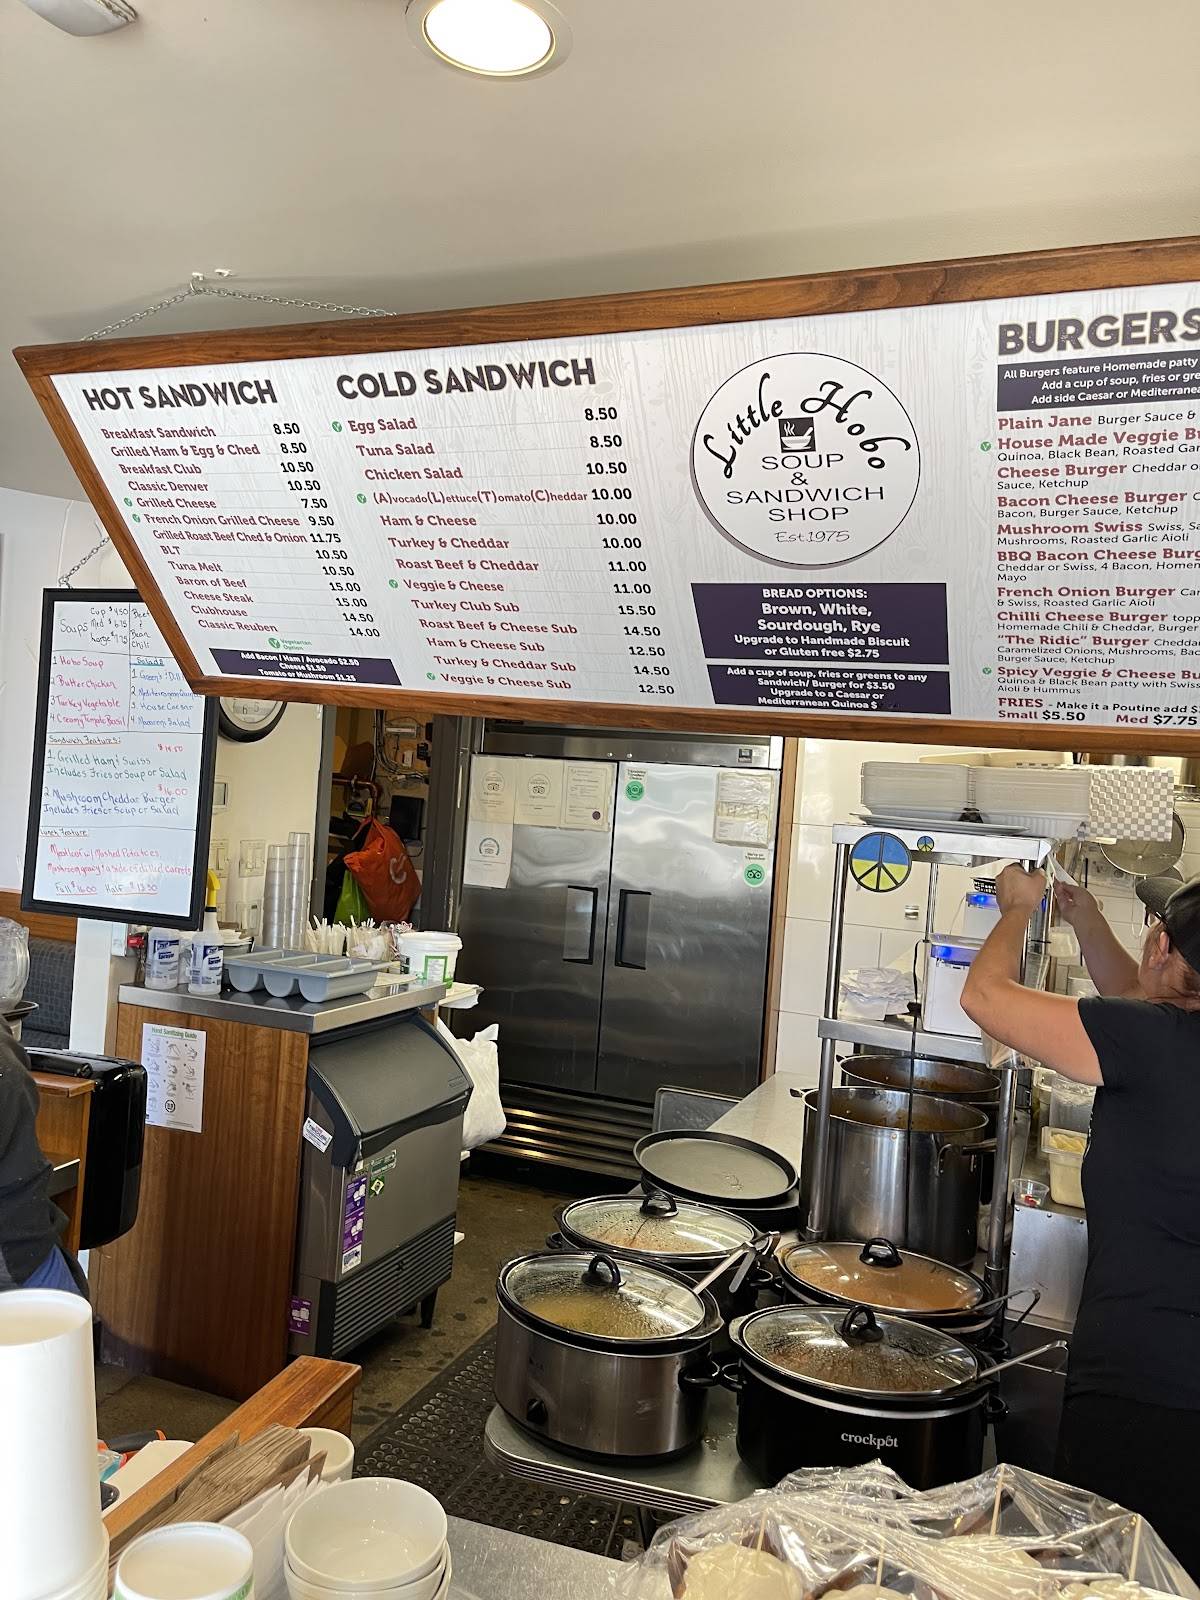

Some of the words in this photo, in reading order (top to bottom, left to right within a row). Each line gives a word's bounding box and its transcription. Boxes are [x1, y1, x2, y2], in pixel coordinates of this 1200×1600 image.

[998, 308, 1200, 356] BURGERS
[1004, 370, 1017, 379] All
[1020, 369, 1060, 378] Burgers
[1062, 366, 1100, 374] feature
[1103, 360, 1166, 371] Homemade
[1169, 358, 1198, 369] patty
[337, 372, 416, 399] COLD
[424, 358, 596, 394] SANDWICH
[82, 387, 134, 410] HOT
[139, 380, 277, 408] SANDWICH
[348, 420, 375, 434] Egg
[378, 418, 417, 430] Salad
[585, 407, 617, 420] 8.50
[704, 373, 782, 478] Little
[800, 380, 911, 469] Hobo
[998, 417, 1043, 430] Plain
[1048, 416, 1092, 427] Jane
[1098, 416, 1141, 425] Burger
[1144, 413, 1182, 422] Sauce
[1187, 410, 1196, 419] &
[101, 428, 156, 438] Breakfast
[157, 426, 216, 438] Sandwich
[273, 423, 300, 434] 8.50
[111, 446, 150, 456] Grilled
[150, 446, 179, 456] Ham
[180, 446, 188, 456] &
[190, 446, 214, 458] Egg
[216, 445, 224, 455] &
[227, 444, 260, 455] Ched
[280, 442, 306, 453] 8.50
[356, 445, 393, 456] Tuna
[396, 443, 435, 455] Salad
[590, 435, 622, 448] 8.50
[118, 464, 172, 474] Breakfast
[174, 464, 201, 474] Club
[280, 462, 314, 472] 10.50
[762, 454, 843, 470] SOUP
[365, 469, 422, 480] Chicken
[424, 467, 463, 479] Salad
[586, 462, 627, 474] 10.50
[998, 467, 1059, 478] Cheese
[1065, 464, 1127, 477] Burger
[1132, 462, 1187, 472] Cheddar
[128, 481, 167, 491] Classic
[168, 482, 208, 491] Denver
[288, 480, 320, 490] 10.50
[791, 472, 808, 485] &
[1040, 479, 1088, 488] Ketchup
[592, 488, 632, 500] 10.00
[727, 487, 883, 504] SANDWICH
[137, 498, 175, 507] Grilled
[176, 498, 216, 508] Cheese
[301, 498, 327, 508] 7.50
[144, 514, 182, 524] French
[182, 515, 217, 524] Onion
[218, 516, 257, 525] Grilled
[258, 516, 300, 526] Cheese
[308, 516, 334, 526] 9.50
[380, 516, 412, 526] Ham
[415, 515, 424, 526] &
[427, 516, 476, 526] Cheese
[597, 514, 636, 524] 10.00
[769, 507, 848, 521] SHOP
[388, 538, 434, 550] Turkey
[438, 538, 447, 548] &
[451, 538, 509, 548] Cheddar
[602, 538, 641, 548] 10.00
[1072, 535, 1118, 544] Roasted
[1122, 534, 1157, 542] Garlic
[1162, 533, 1188, 541] Aioli
[160, 546, 180, 555] BLT
[316, 550, 347, 559] 10.50
[168, 561, 197, 570] Tuna
[198, 562, 223, 572] Melt
[322, 566, 354, 576] 10.50
[396, 559, 433, 569] Roast
[434, 560, 464, 569] Beef
[468, 560, 476, 570] &
[480, 560, 538, 570] Cheddar
[608, 561, 646, 571] 11.00
[763, 589, 803, 598] BREAD
[806, 589, 867, 598] OPTIONS:
[191, 606, 248, 616] Clubhouse
[343, 613, 373, 622] 14.50
[411, 600, 456, 612] Turkey
[460, 602, 491, 611] Club
[494, 602, 519, 612] Sub
[618, 606, 656, 615] 15.50
[762, 603, 816, 616] Brown,
[820, 604, 872, 616] White,
[998, 612, 1040, 621] Chilli
[1046, 612, 1104, 621] Cheese
[1110, 612, 1168, 624] Burger
[198, 620, 235, 629] Classic
[236, 622, 278, 632] Reuben
[350, 628, 380, 637] 14.00
[758, 619, 847, 634] Sourdough,
[851, 620, 880, 634] Rye
[734, 635, 783, 645] Upgrade
[786, 636, 798, 644] to
[801, 636, 865, 645] Handmade
[868, 637, 910, 646] Biscuit
[1092, 636, 1149, 648] Burger
[779, 647, 818, 656] Gluten
[821, 648, 845, 657] free
[848, 648, 879, 658] $2.75
[440, 674, 484, 685] Veggie
[487, 676, 494, 684] &
[498, 677, 544, 687] Cheese
[546, 680, 571, 688] Sub
[639, 685, 674, 694] 12.50
[812, 680, 846, 689] Burger
[866, 681, 895, 690] $3.50
[998, 710, 1038, 719] Small
[1042, 710, 1085, 721] $5.50
[1116, 715, 1148, 723] Med
[1154, 714, 1197, 725] $7.75
[841, 1433, 898, 1450] crockpot
